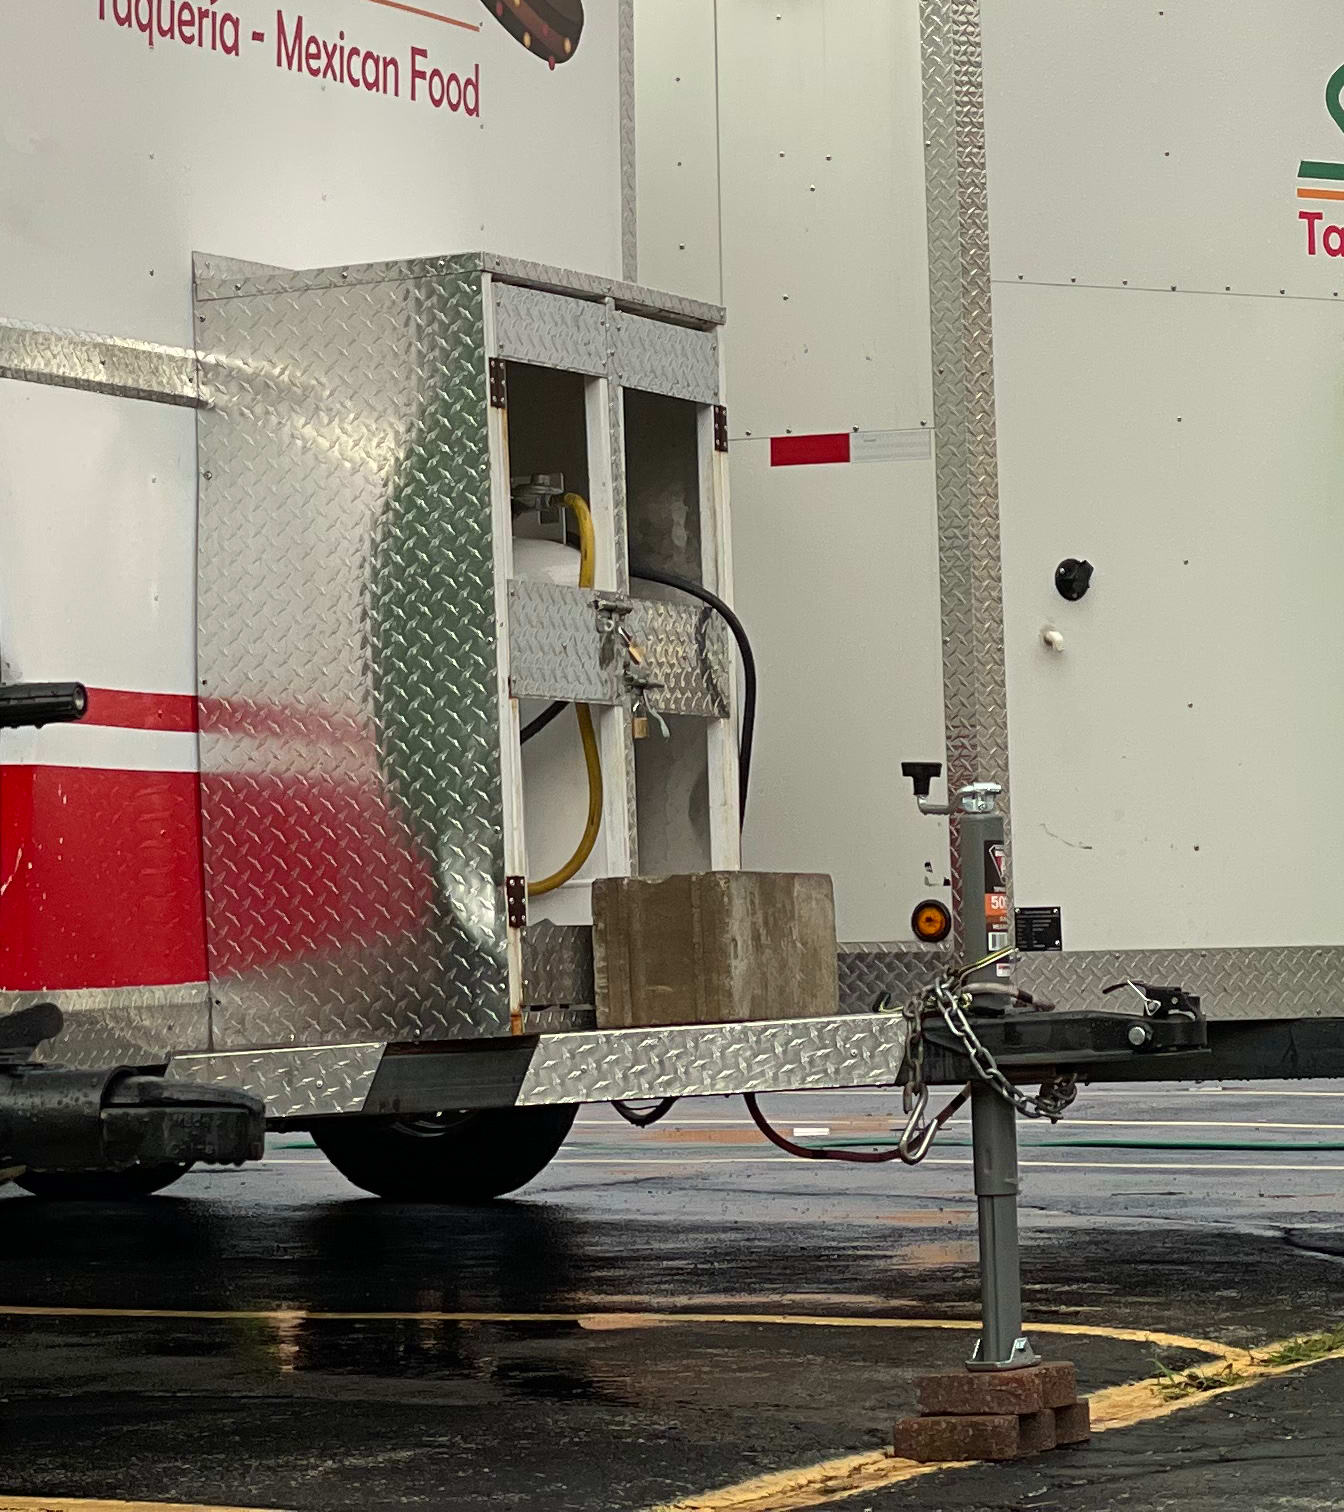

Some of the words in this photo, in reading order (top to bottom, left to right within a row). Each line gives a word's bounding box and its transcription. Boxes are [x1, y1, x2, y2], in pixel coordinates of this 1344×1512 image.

[251, 30, 265, 43] -
[276, 9, 400, 98] Mexican
[410, 46, 480, 118] Food
[991, 895, 1007, 909] 50
